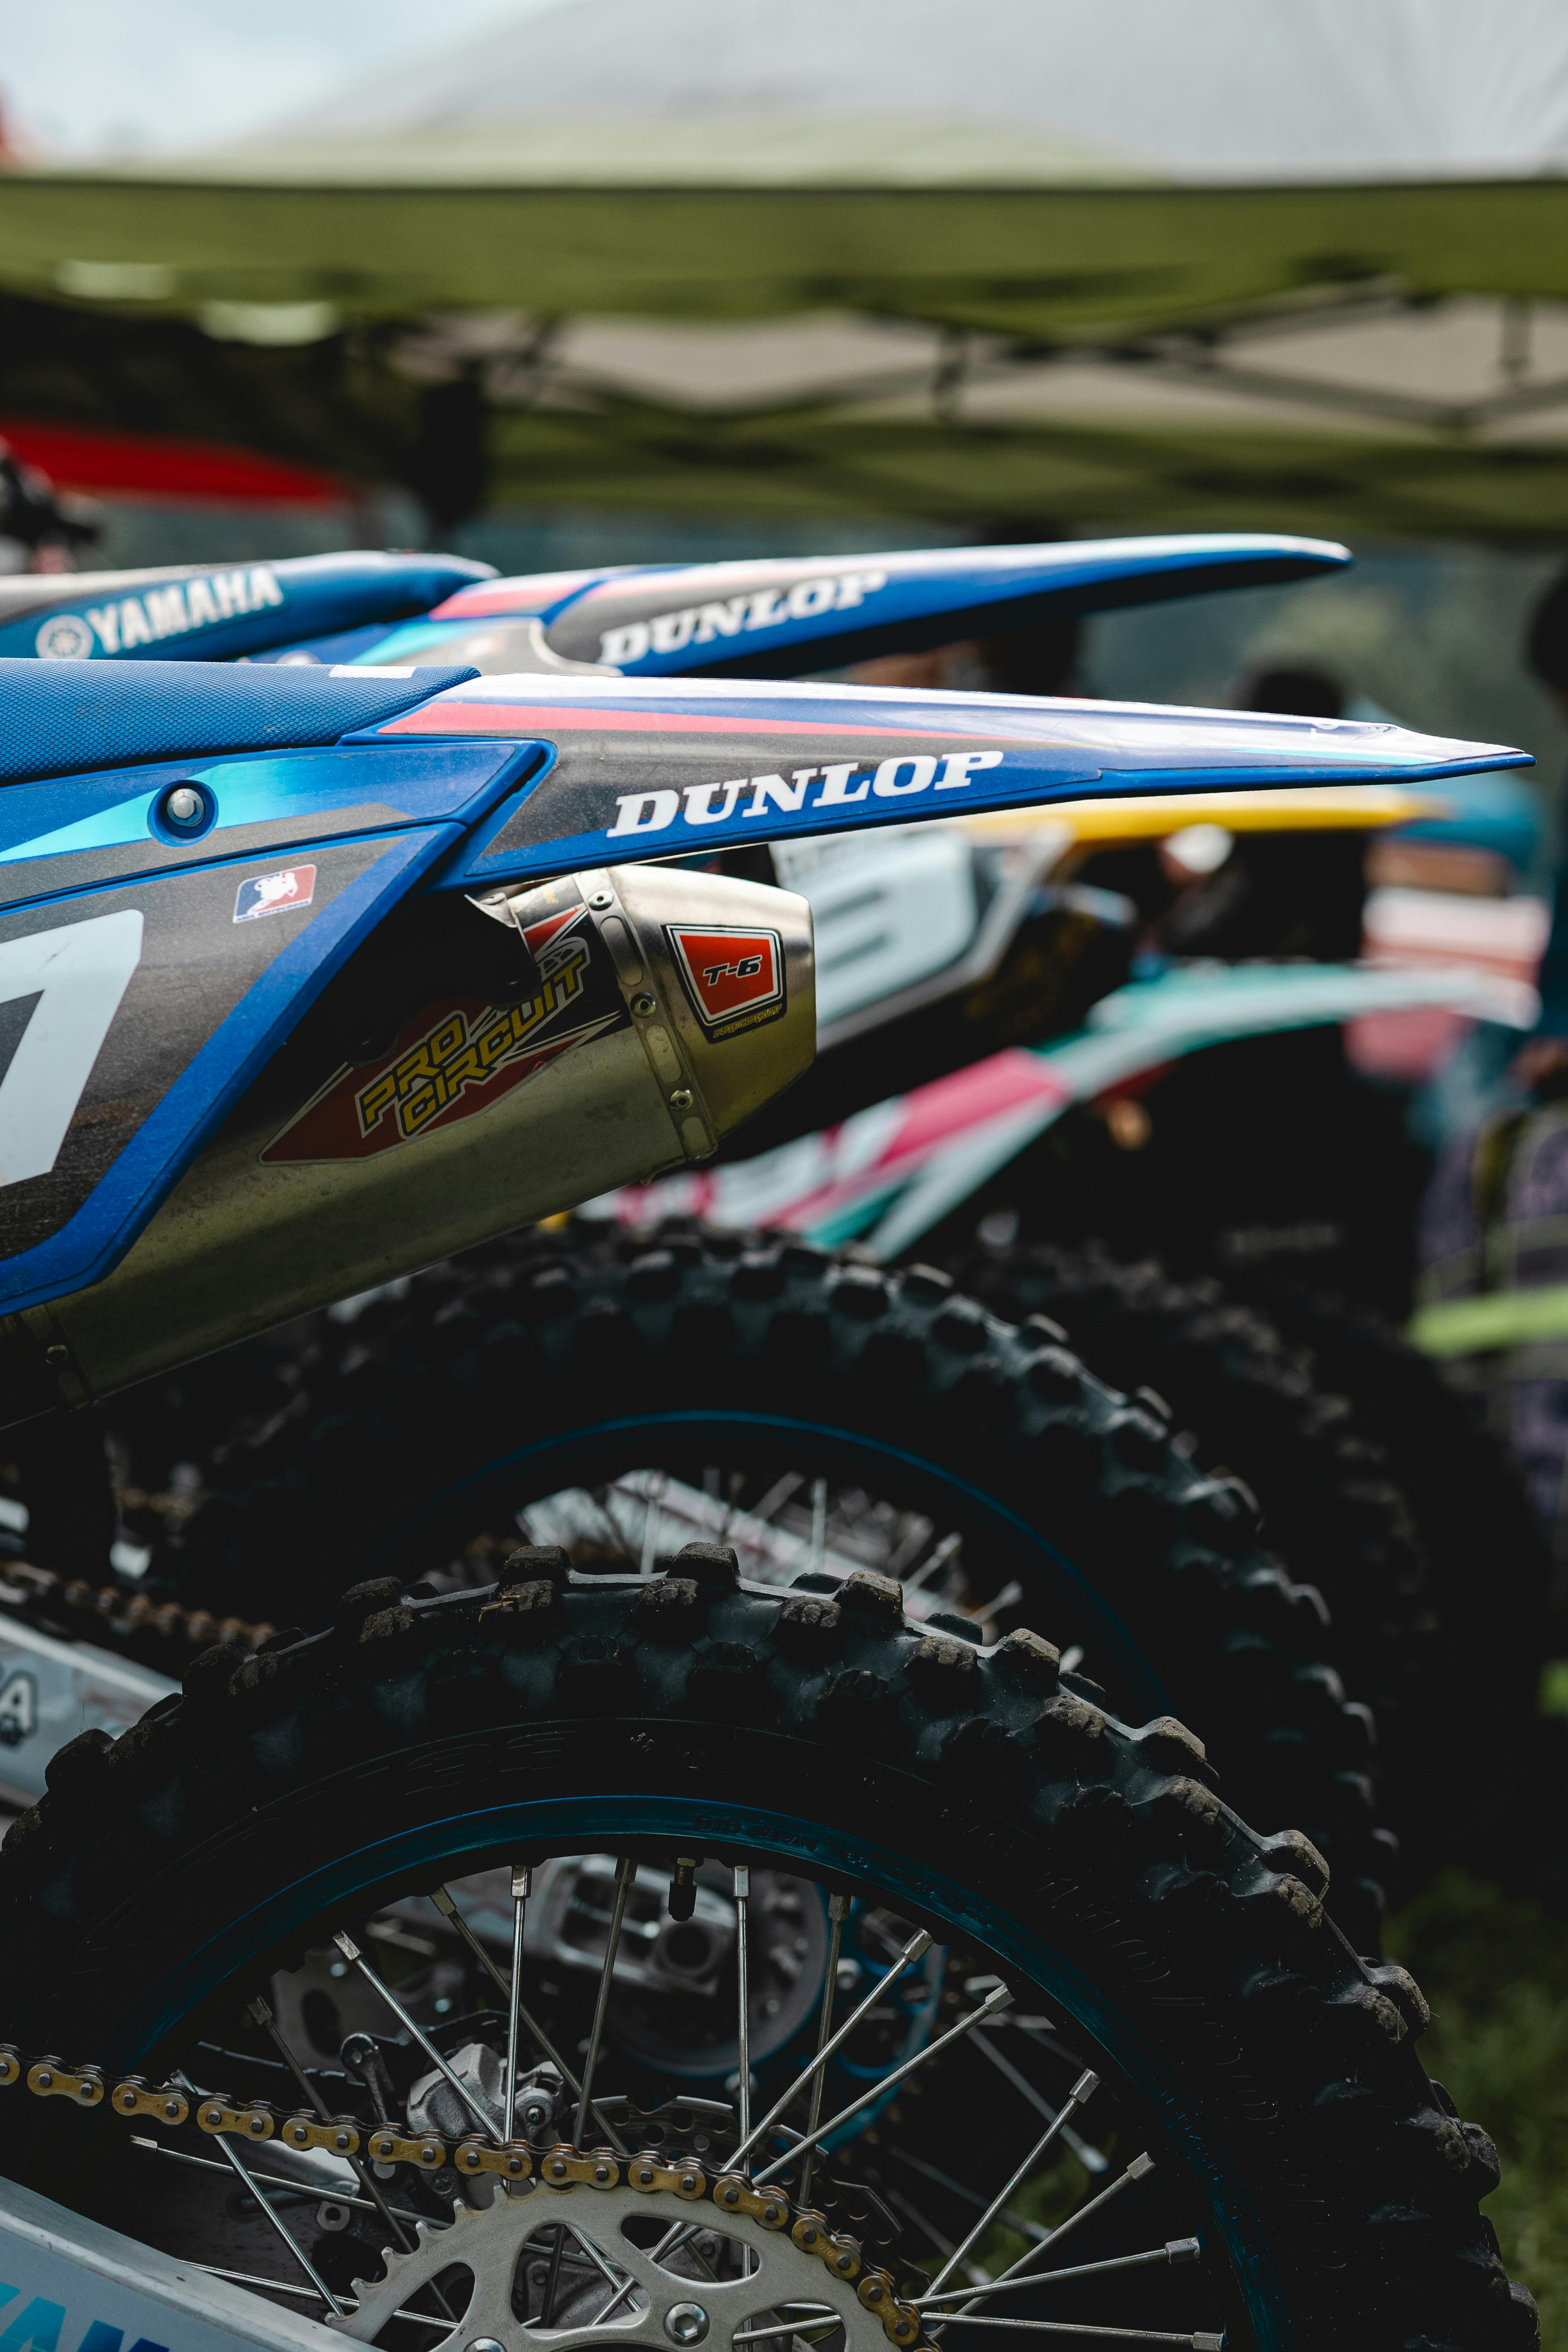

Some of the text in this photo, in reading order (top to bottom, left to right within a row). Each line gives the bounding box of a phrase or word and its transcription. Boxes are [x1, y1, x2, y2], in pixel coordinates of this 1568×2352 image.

[84, 565, 284, 654] YAMAHA
[597, 570, 889, 666] DUNLOP
[606, 750, 1004, 838] DUNLOP
[703, 954, 763, 986] T-6
[400, 952, 586, 1135] CIRCUIT
[713, 1004, 782, 1038] PRO CIRCUIT
[360, 1014, 466, 1130] PRO
